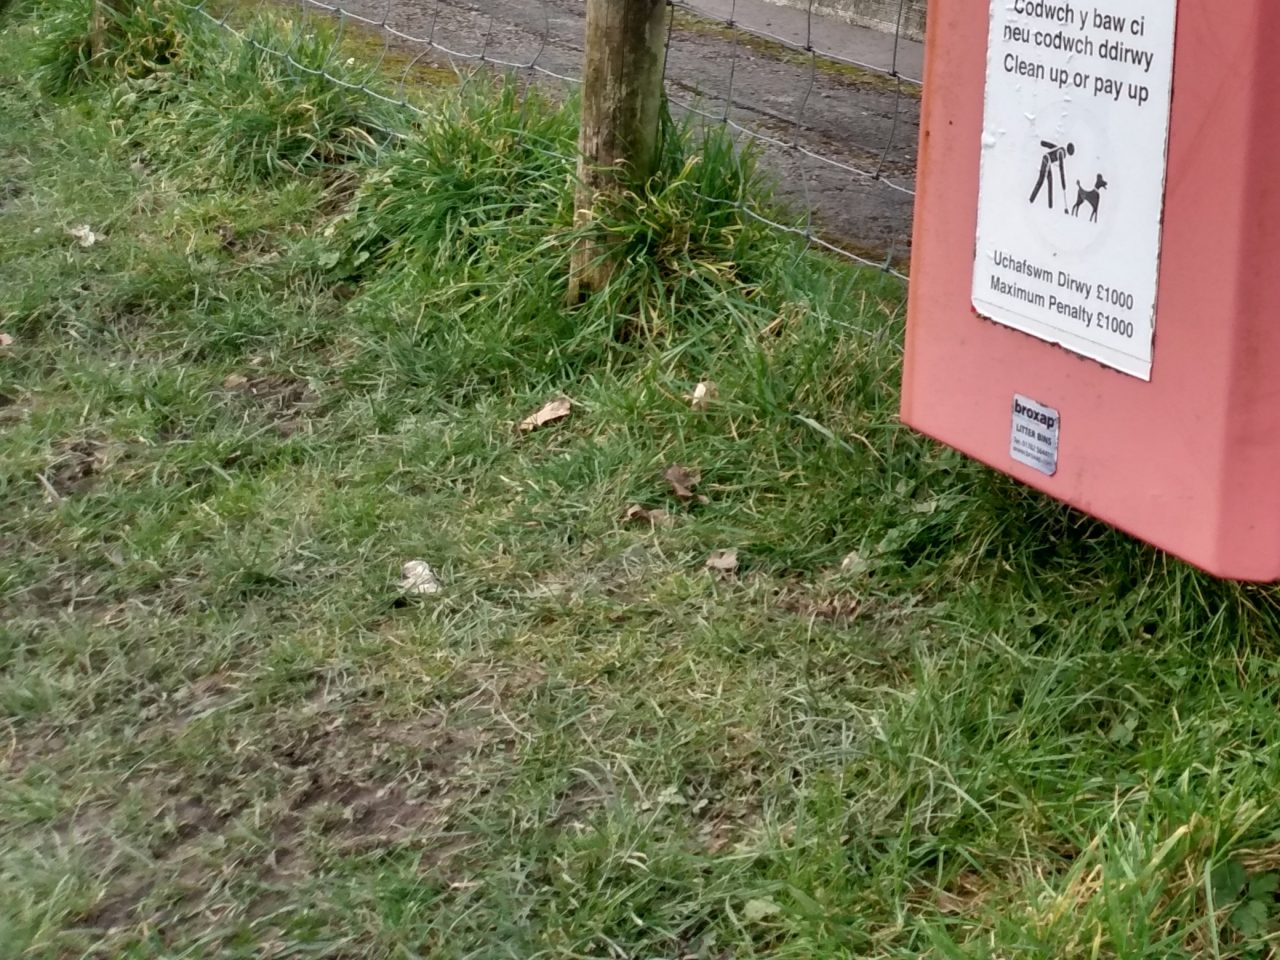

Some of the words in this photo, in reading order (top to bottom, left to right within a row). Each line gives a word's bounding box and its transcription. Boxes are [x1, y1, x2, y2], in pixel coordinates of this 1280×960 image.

[1079, 9, 1089, 31] y
[1093, 8, 1125, 33] baw
[1130, 16, 1145, 36] ci
[1003, 23, 1030, 44] neu
[1034, 30, 1094, 56] codwch
[1098, 40, 1154, 72] ddirwy
[1003, 53, 1045, 80] Clean
[1050, 66, 1069, 88] up
[1073, 71, 1090, 89] or
[1094, 76, 1123, 101] pay
[1128, 83, 1149, 107] up
[993, 250, 1053, 284] Uchafswm
[1057, 271, 1092, 300] Dirwy
[1096, 284, 1134, 310] £1000
[990, 275, 1045, 308] Maximum
[1049, 295, 1093, 327] Penalty
[1096, 312, 1134, 339] £1000
[1014, 399, 1055, 429] broxap
[1016, 423, 1036, 438] LITTER
